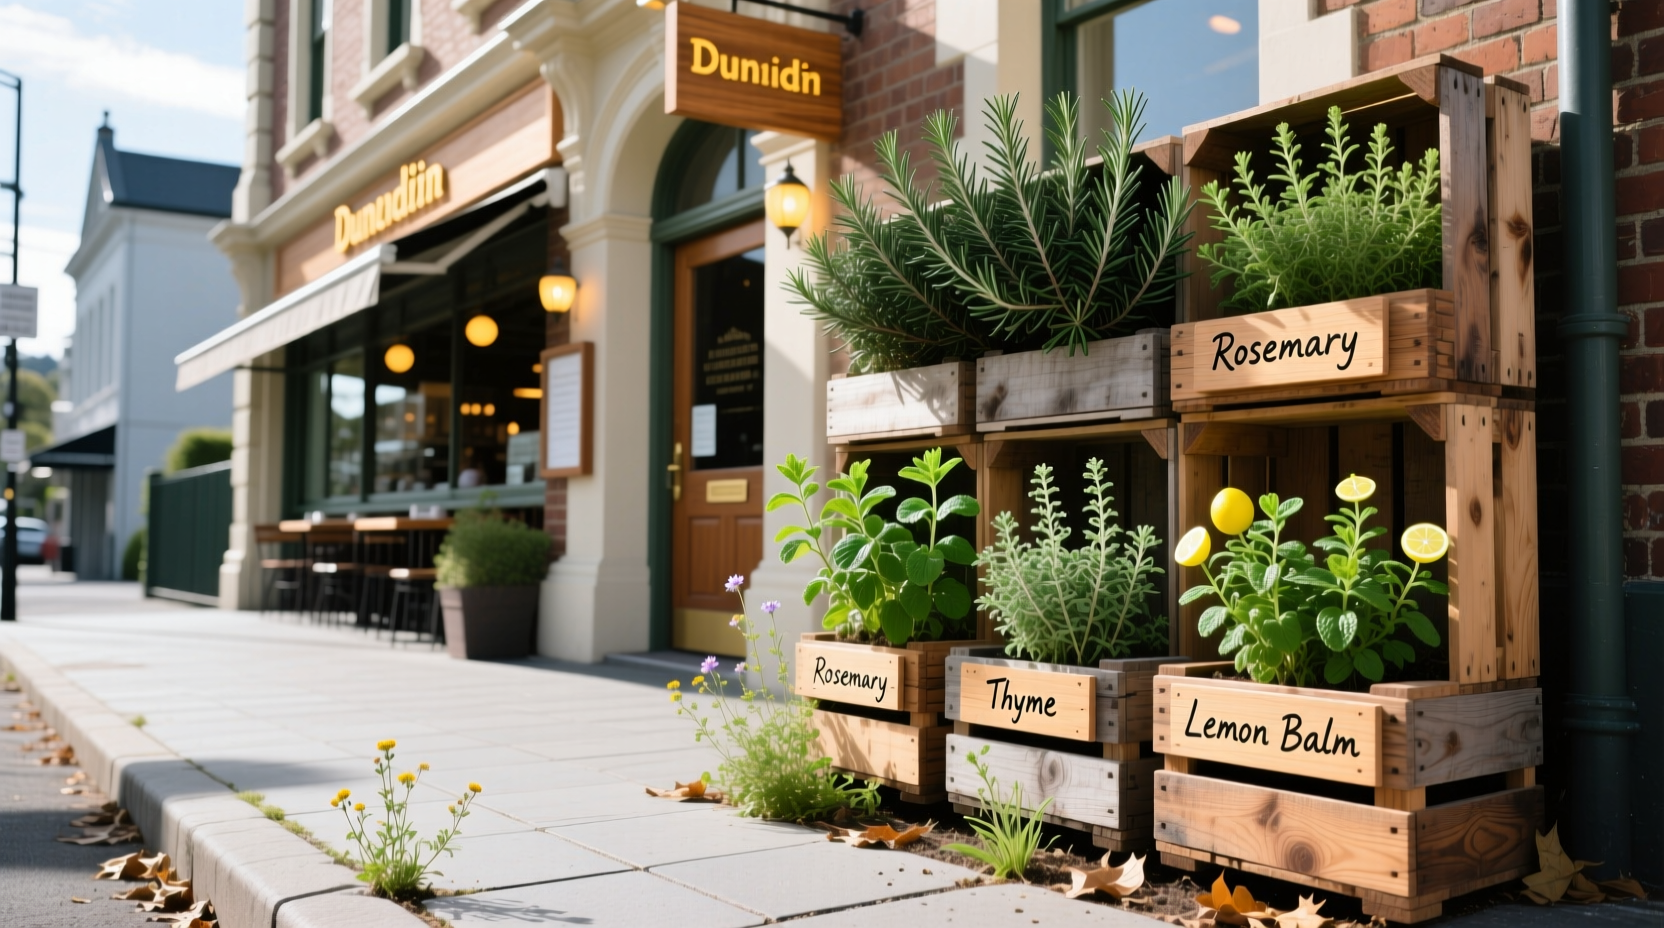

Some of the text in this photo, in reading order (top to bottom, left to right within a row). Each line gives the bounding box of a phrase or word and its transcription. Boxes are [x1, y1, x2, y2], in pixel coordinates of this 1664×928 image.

[1212, 331, 1358, 372] Rosemary
[813, 656, 888, 703] Rosemary
[986, 677, 1057, 724] Thyme
[1184, 698, 1361, 758] Lemon Balm
